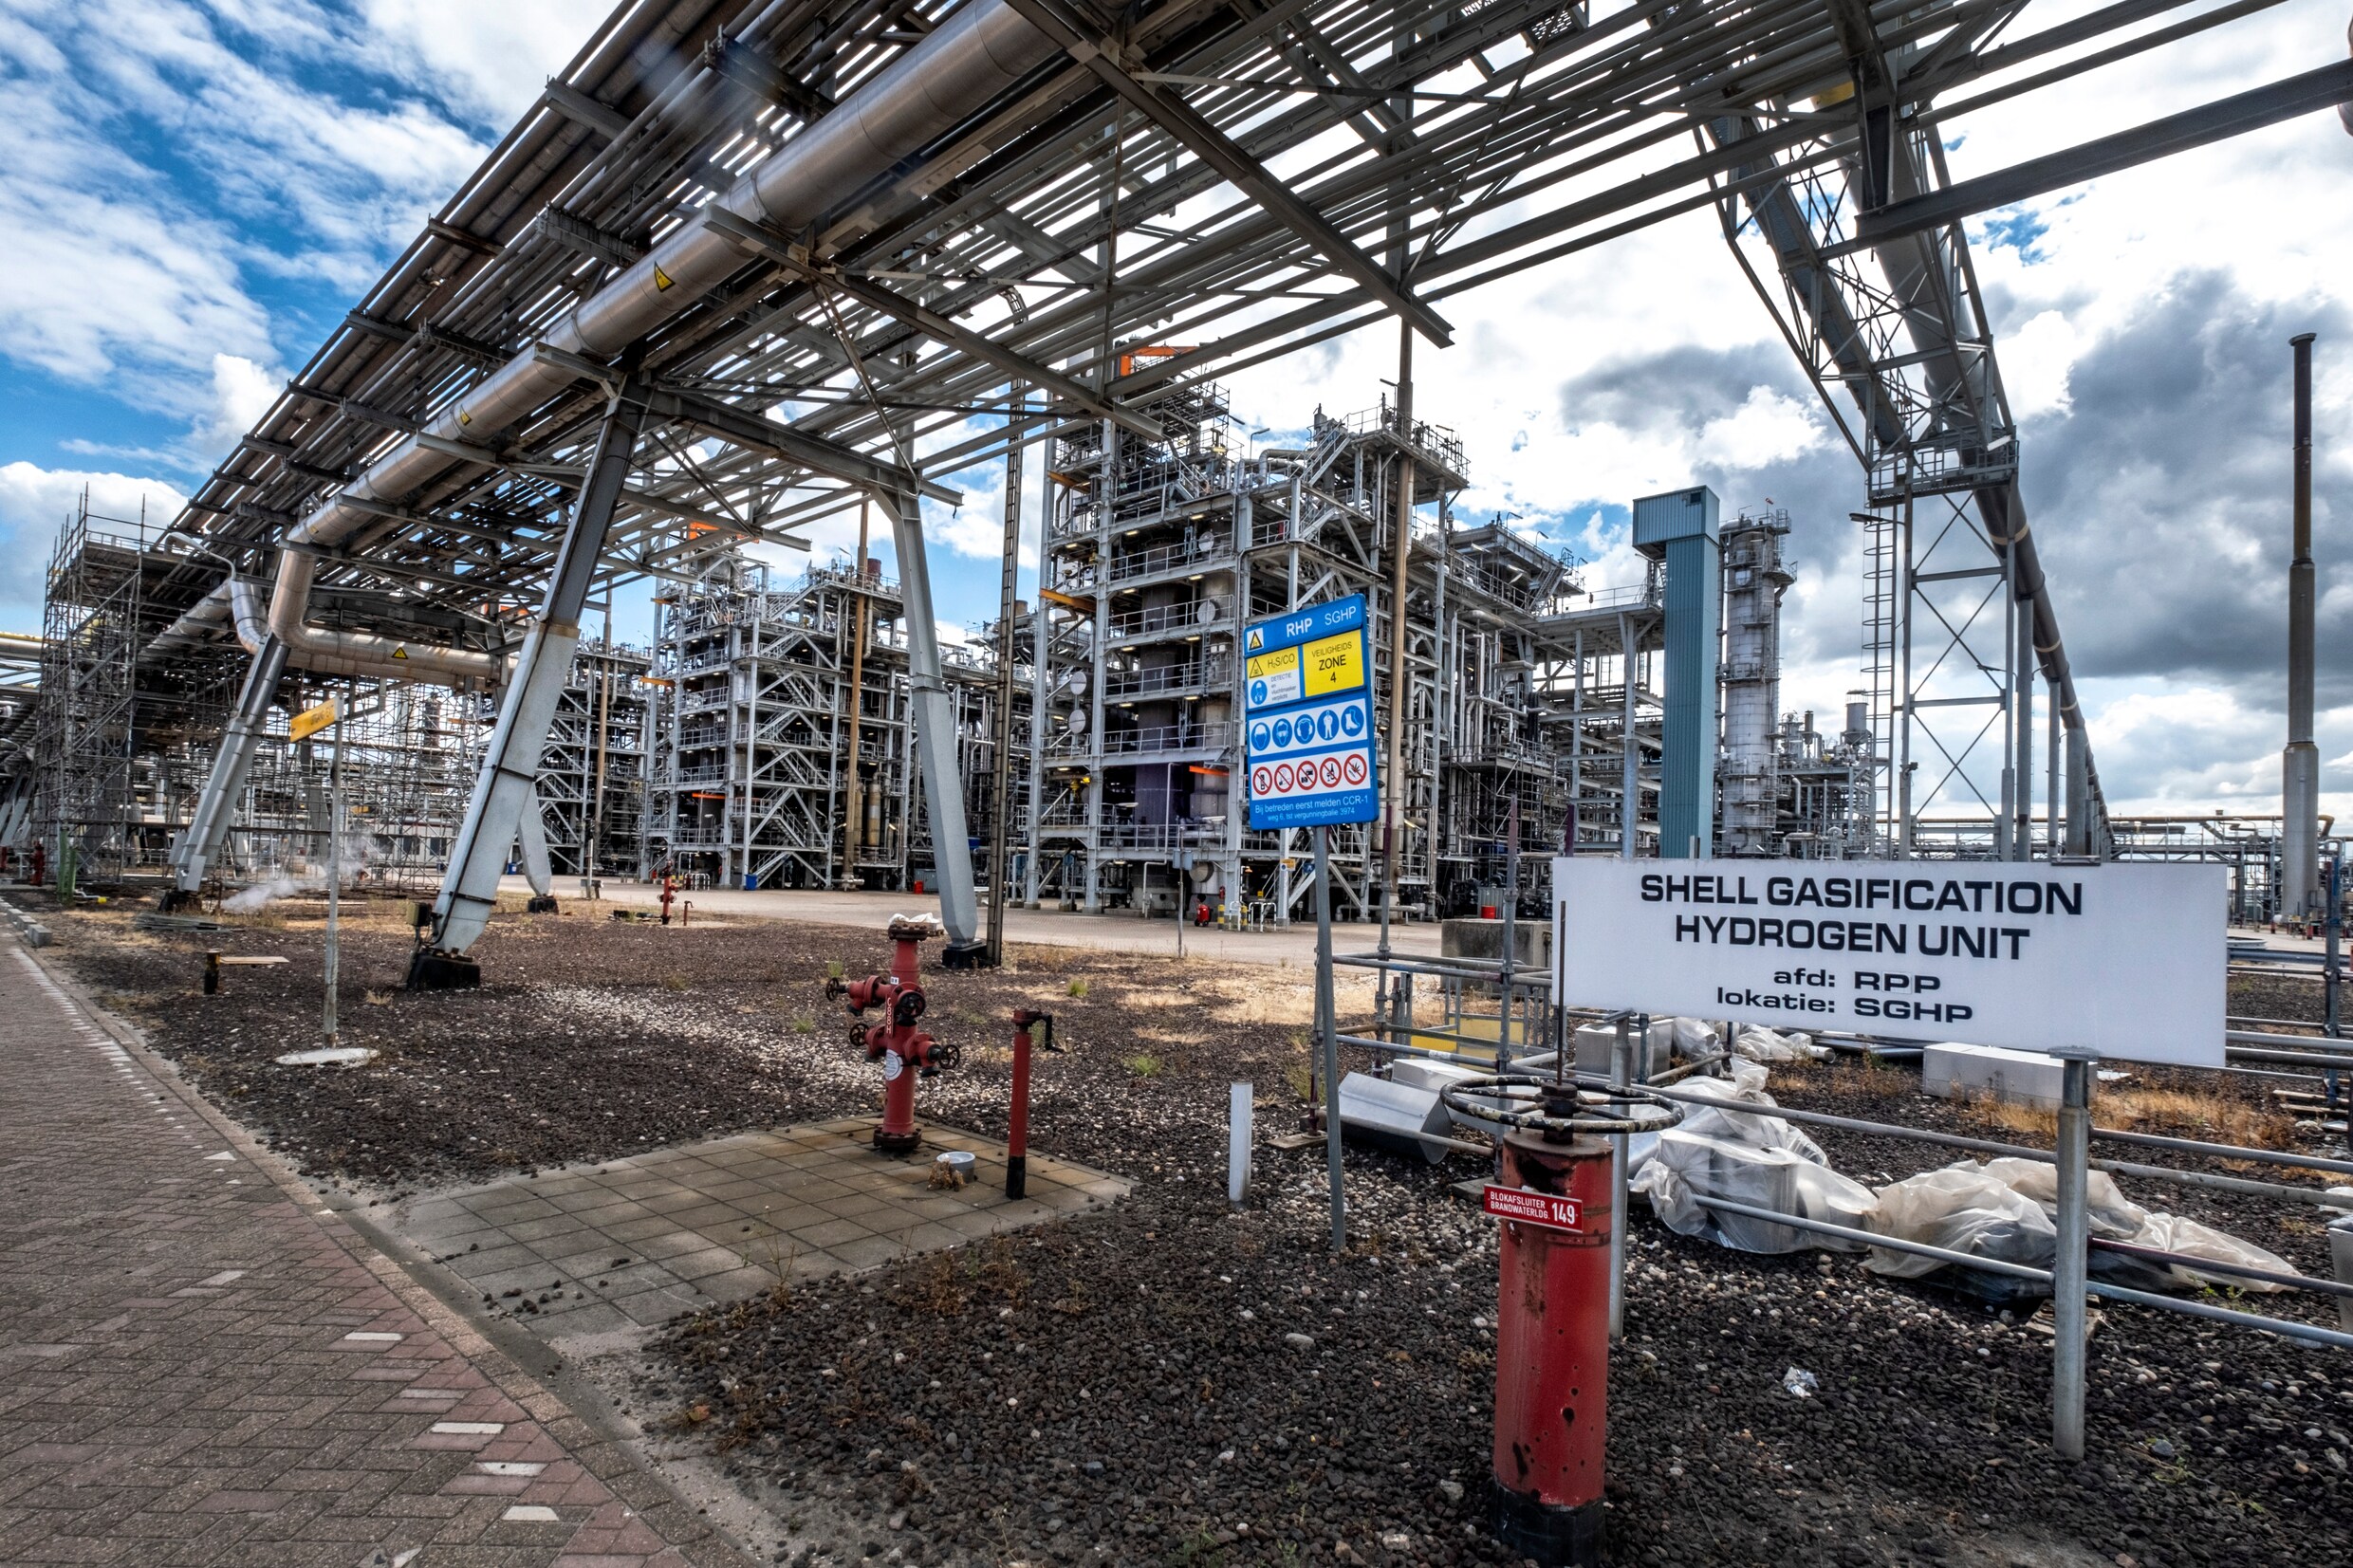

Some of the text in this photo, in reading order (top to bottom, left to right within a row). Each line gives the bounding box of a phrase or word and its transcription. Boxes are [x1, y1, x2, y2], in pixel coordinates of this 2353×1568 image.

[1287, 606, 1357, 637] RHP SGHP
[1311, 641, 1352, 657] VEILIGHEIDS
[1319, 655, 1346, 671] ZONE
[1330, 672, 1337, 683] 4
[1255, 795, 1368, 815] Bij betreden eerst melden CCR-1
[1640, 874, 2083, 915] SHELL GASIFICATION
[1676, 914, 2030, 960] HYDROGEN UNIT
[1773, 968, 1941, 994] afd: RPP
[1717, 987, 1973, 1024] lokatie: SGHP
[1490, 1190, 1546, 1209] BLOKAFSLUITER
[1551, 1202, 1575, 1225] 149
